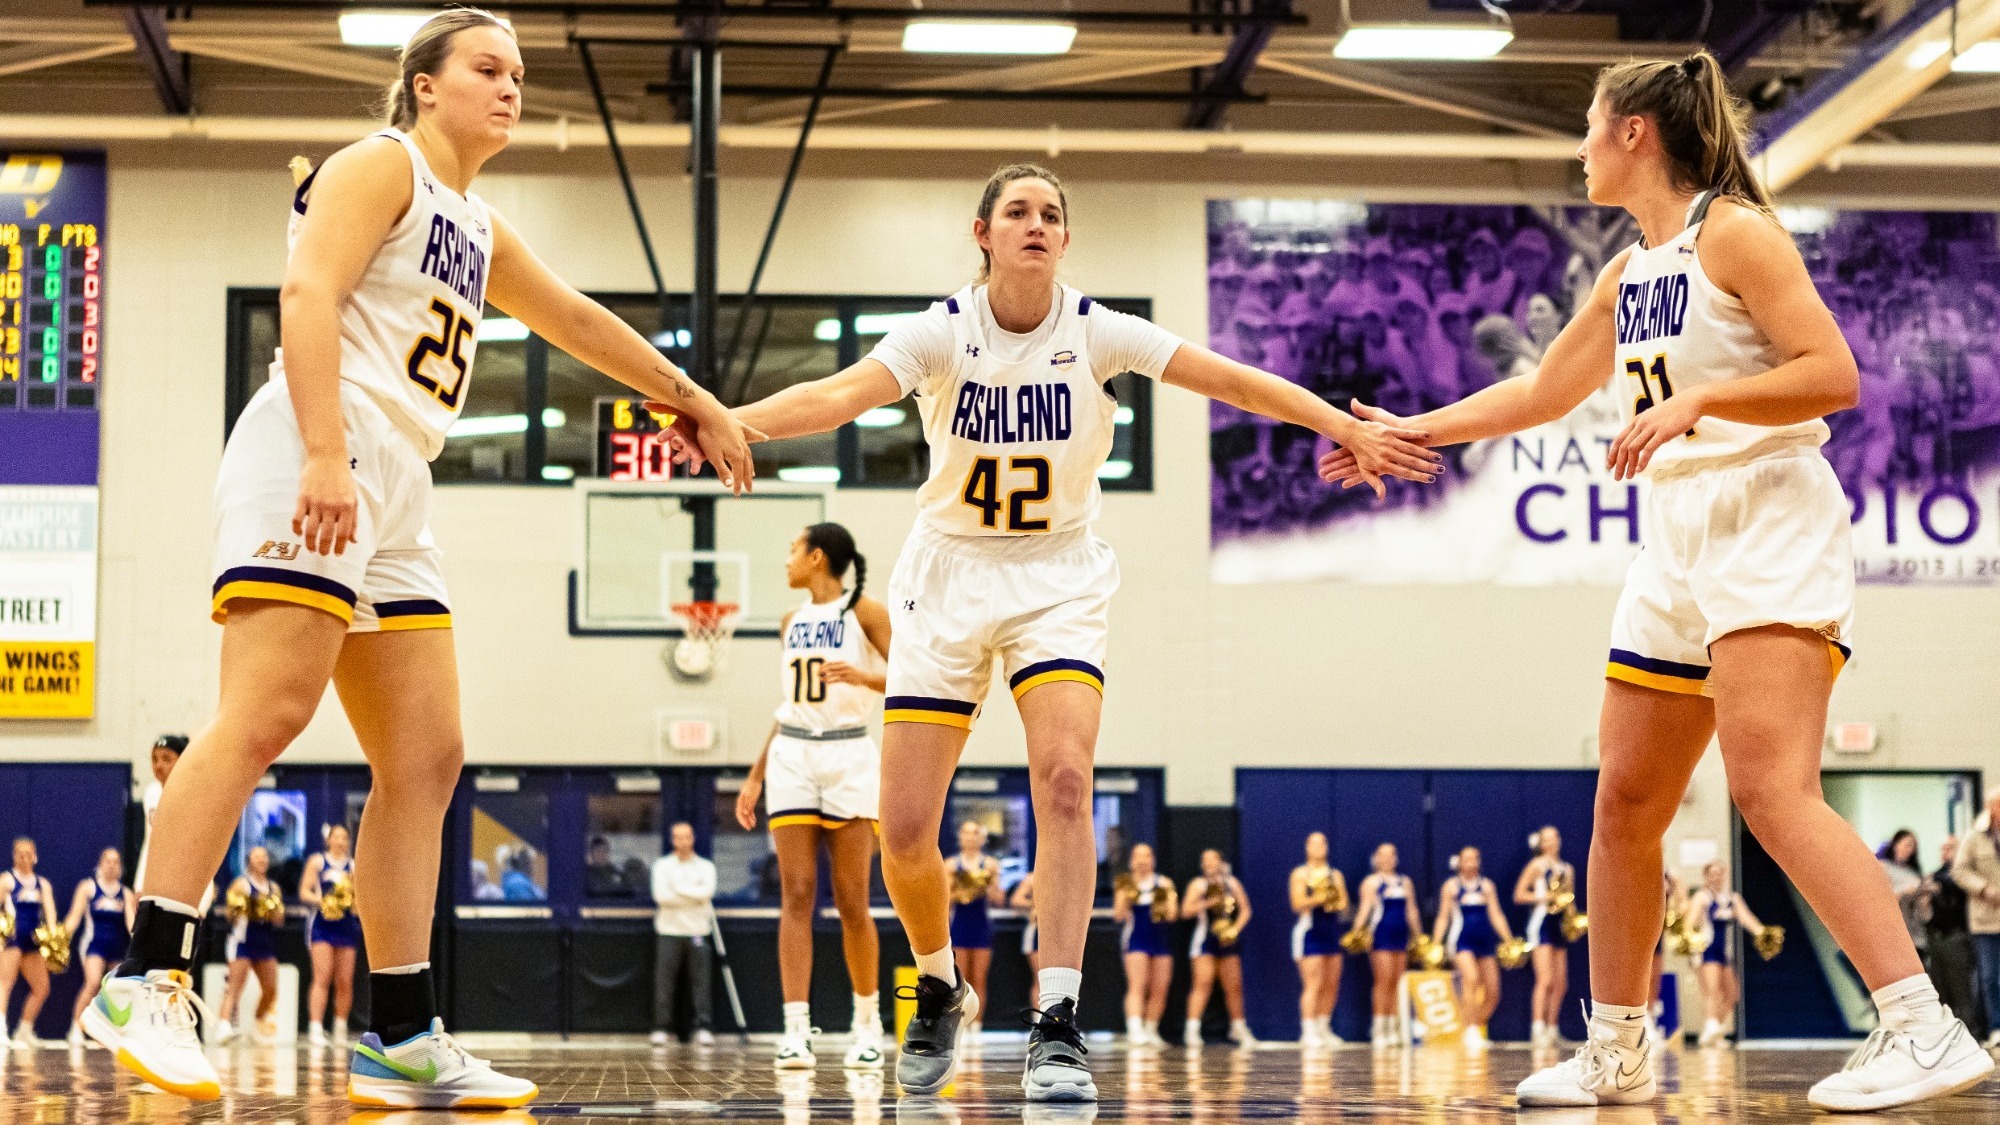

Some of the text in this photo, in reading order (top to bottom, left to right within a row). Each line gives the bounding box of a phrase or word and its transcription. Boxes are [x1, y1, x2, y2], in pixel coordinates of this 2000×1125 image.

[62, 223, 97, 247] PTS
[8, 244, 100, 271] 3 0 2
[44, 271, 62, 300] 0
[83, 272, 99, 299] 0
[52, 301, 61, 327] 1
[84, 301, 98, 327] 3
[42, 327, 60, 355] 0
[81, 327, 98, 355] 0
[406, 295, 475, 412] 25
[42, 356, 59, 383] 0
[81, 357, 97, 383] 2
[951, 380, 1072, 444] ASHLAND
[610, 432, 672, 482] 30
[961, 455, 1053, 533] 42
[788, 620, 845, 649] ASHLAND
[6, 650, 80, 670] WINGS
[23, 675, 80, 697] GAME!
[790, 656, 827, 703] 10
